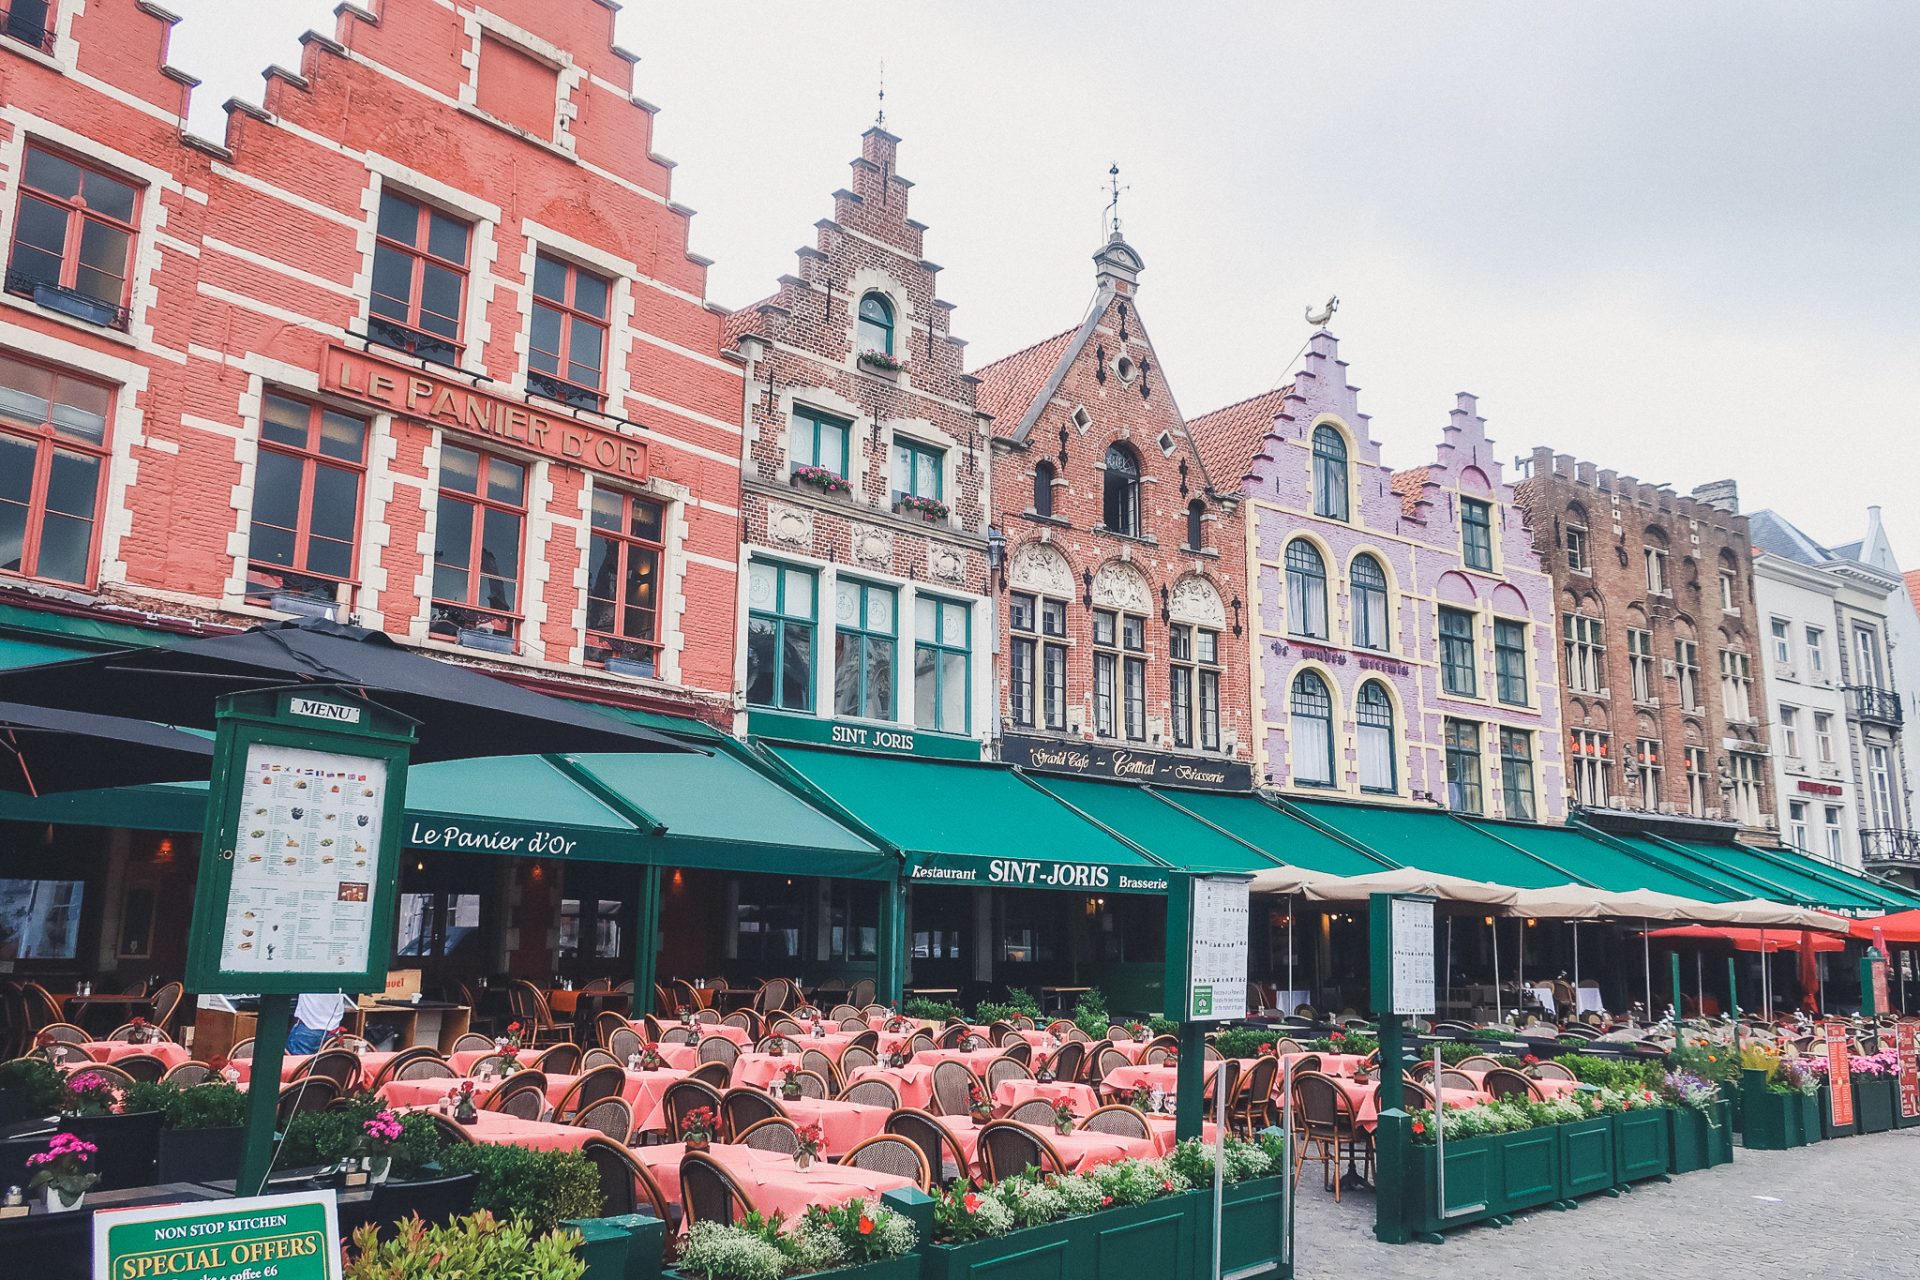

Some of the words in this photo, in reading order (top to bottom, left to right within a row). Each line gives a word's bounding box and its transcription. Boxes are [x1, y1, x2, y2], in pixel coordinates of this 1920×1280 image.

[340, 361, 394, 402] LE
[407, 376, 550, 449] PANIER
[562, 431, 640, 475] D'OR
[300, 701, 351, 719] MENU
[832, 726, 867, 744] SINT
[873, 731, 914, 750] JORIS
[1032, 748, 1067, 768] Grand
[1112, 751, 1157, 776] Central
[1175, 765, 1225, 783] Brasserie
[411, 822, 441, 844] Le
[444, 826, 524, 851] Panier
[528, 832, 577, 855] d'Or
[911, 864, 977, 880] Restaurant
[988, 859, 1109, 887] SINT-JORIS
[1119, 876, 1168, 890] Brasserie
[154, 1227, 187, 1241] NON
[190, 1221, 225, 1237] STOP
[228, 1214, 288, 1232] KITCHEN
[122, 1247, 226, 1280] SPECIAL
[231, 1235, 317, 1265] OFFERS
[230, 1268, 262, 1280] coffee
[264, 1264, 278, 1277] €6
